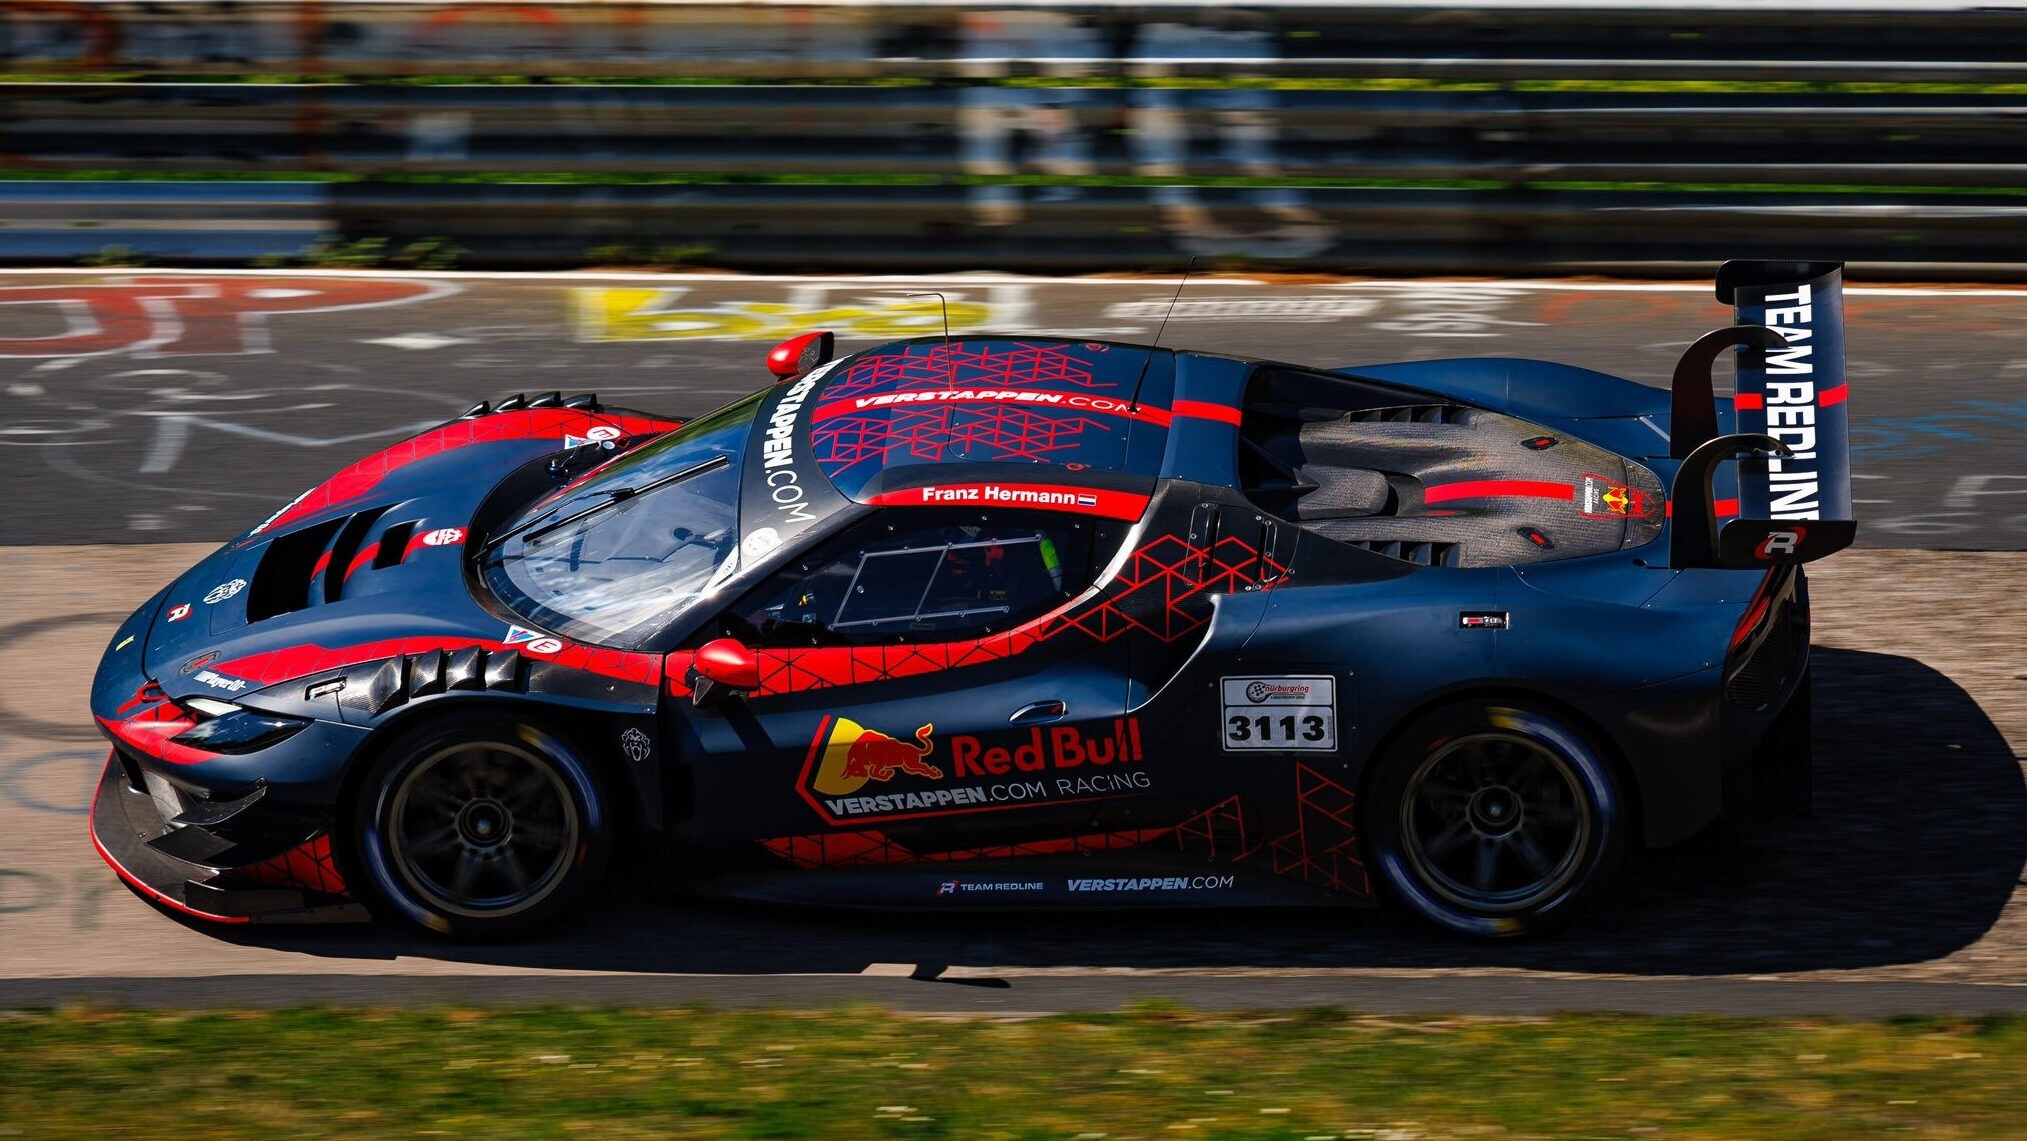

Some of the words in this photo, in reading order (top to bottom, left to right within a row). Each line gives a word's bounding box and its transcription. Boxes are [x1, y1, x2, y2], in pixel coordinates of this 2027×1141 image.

[1764, 283, 1813, 375] TEAM
[922, 487, 979, 501] Franz
[984, 486, 1075, 505] Hermann
[1228, 715, 1325, 741] 3113
[951, 727, 1045, 778] Red
[1050, 717, 1143, 768] Bull
[824, 781, 1047, 816] VERSTAPPEN.COM
[1056, 771, 1151, 796] RACING
[960, 883, 993, 891] TEAM
[995, 882, 1043, 890] REDLINE
[1067, 875, 1235, 892] VERSTAPPEN.COM
